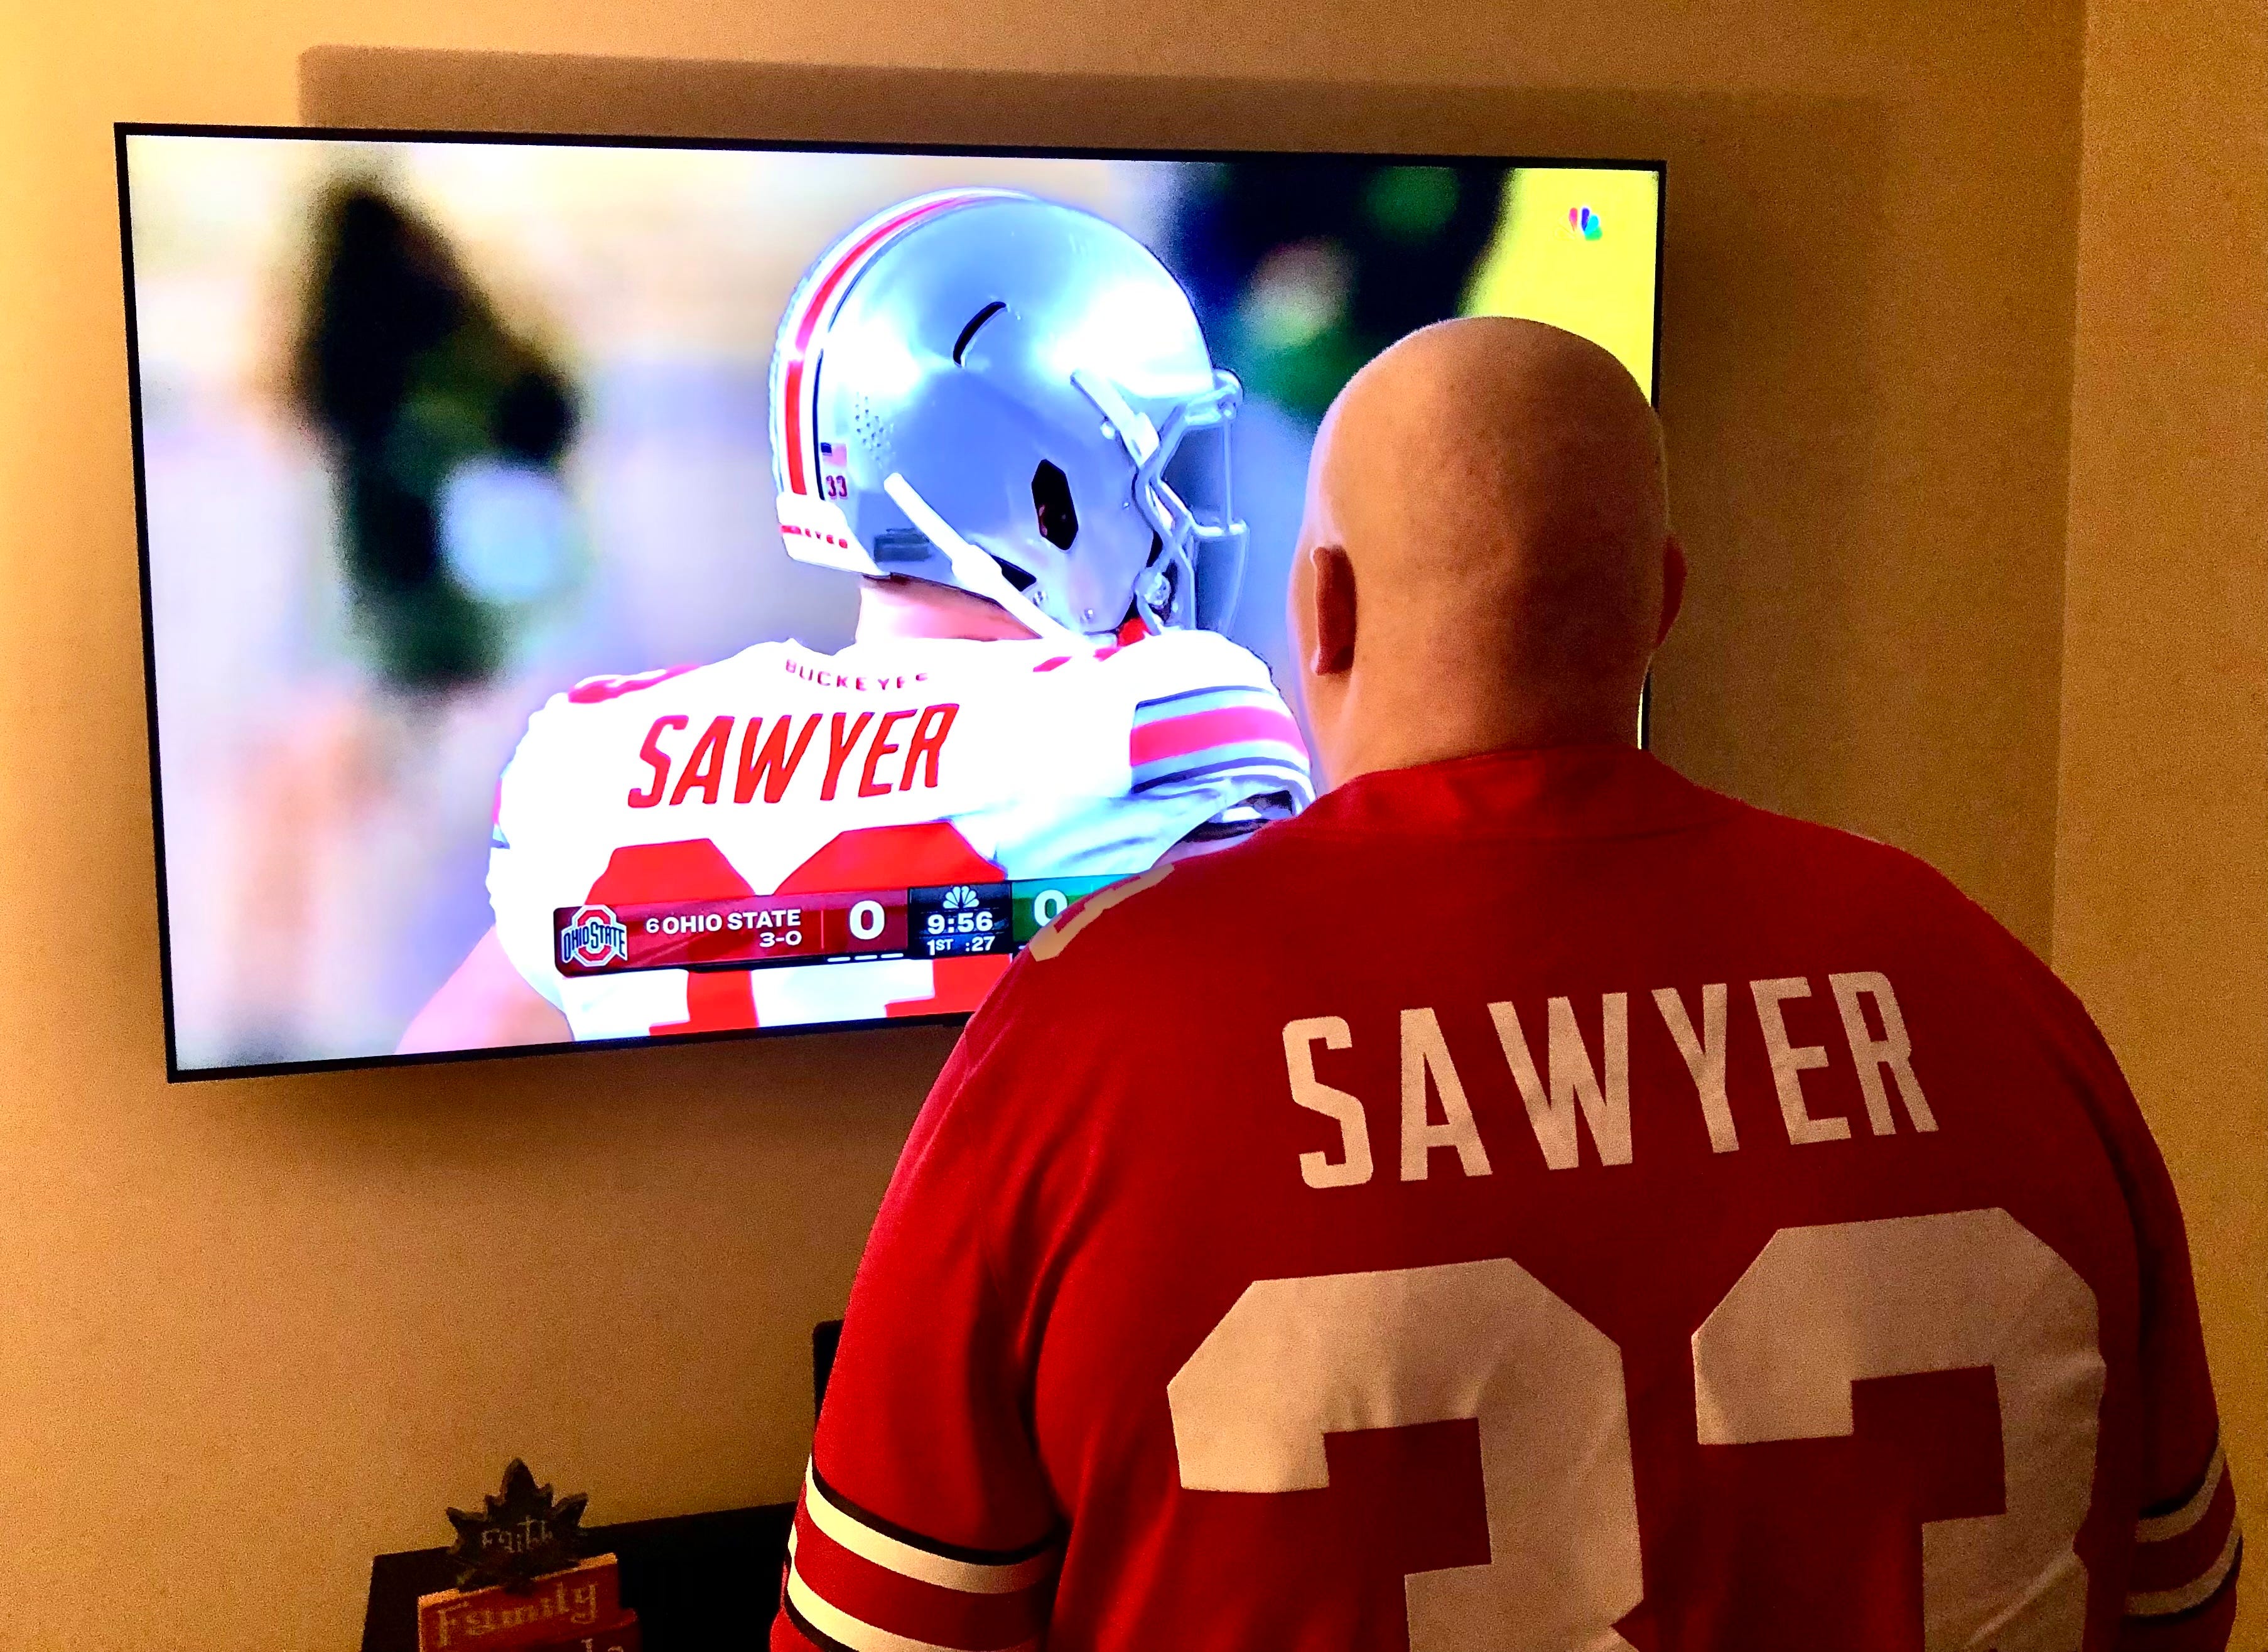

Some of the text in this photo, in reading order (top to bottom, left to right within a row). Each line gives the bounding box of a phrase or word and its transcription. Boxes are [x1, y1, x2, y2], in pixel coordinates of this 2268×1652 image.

[826, 475, 848, 499] 33
[628, 703, 960, 809] SAWYER
[645, 909, 801, 934] 6 OHIO STATE
[849, 899, 885, 940] 0
[927, 911, 993, 935] 9:56
[1034, 889, 1067, 927] 0
[759, 931, 802, 948] 3-0
[927, 936, 995, 956] 1ST :27
[1282, 971, 1939, 1190] SAWYER
[1167, 1206, 2107, 1652] 33
[438, 1582, 598, 1648] Family
